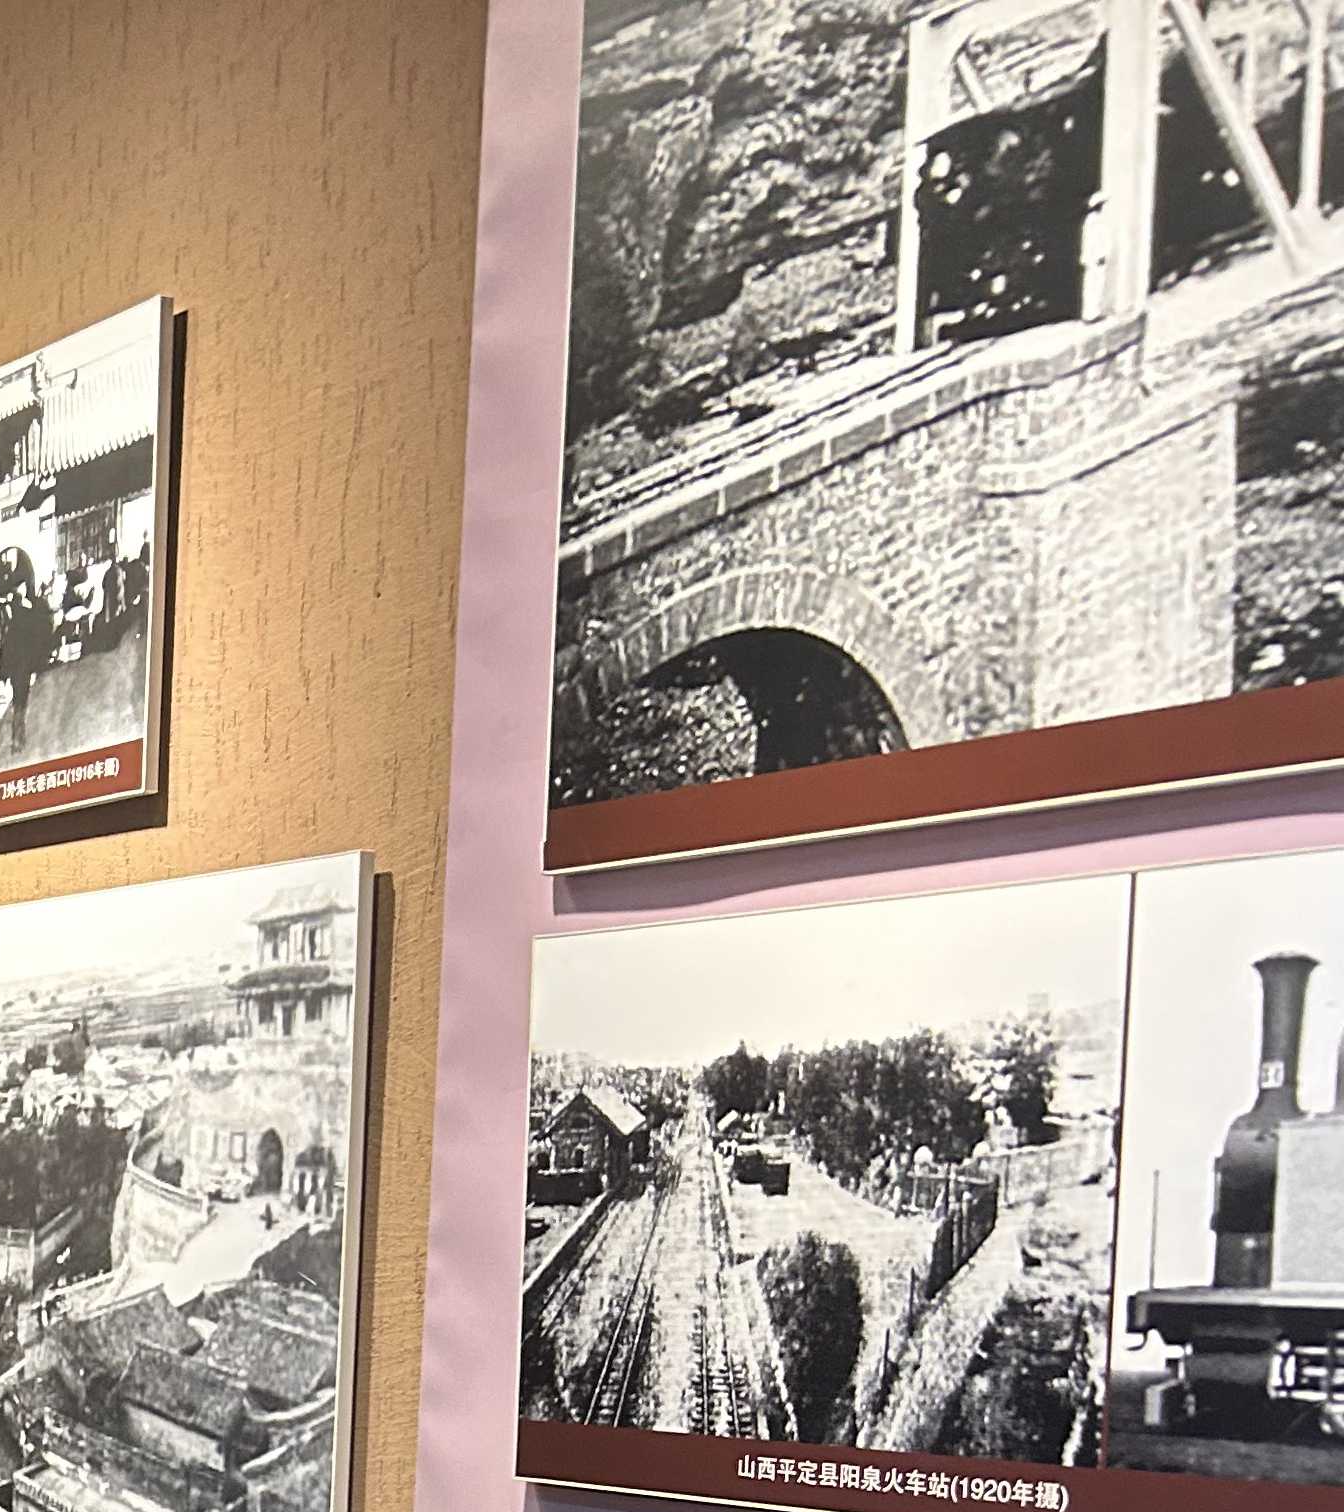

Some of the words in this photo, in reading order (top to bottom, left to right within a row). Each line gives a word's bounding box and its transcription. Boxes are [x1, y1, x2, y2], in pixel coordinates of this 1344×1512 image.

[737, 1454, 1069, 1512] 山西平定县阳泉火车站(1920年摄)
